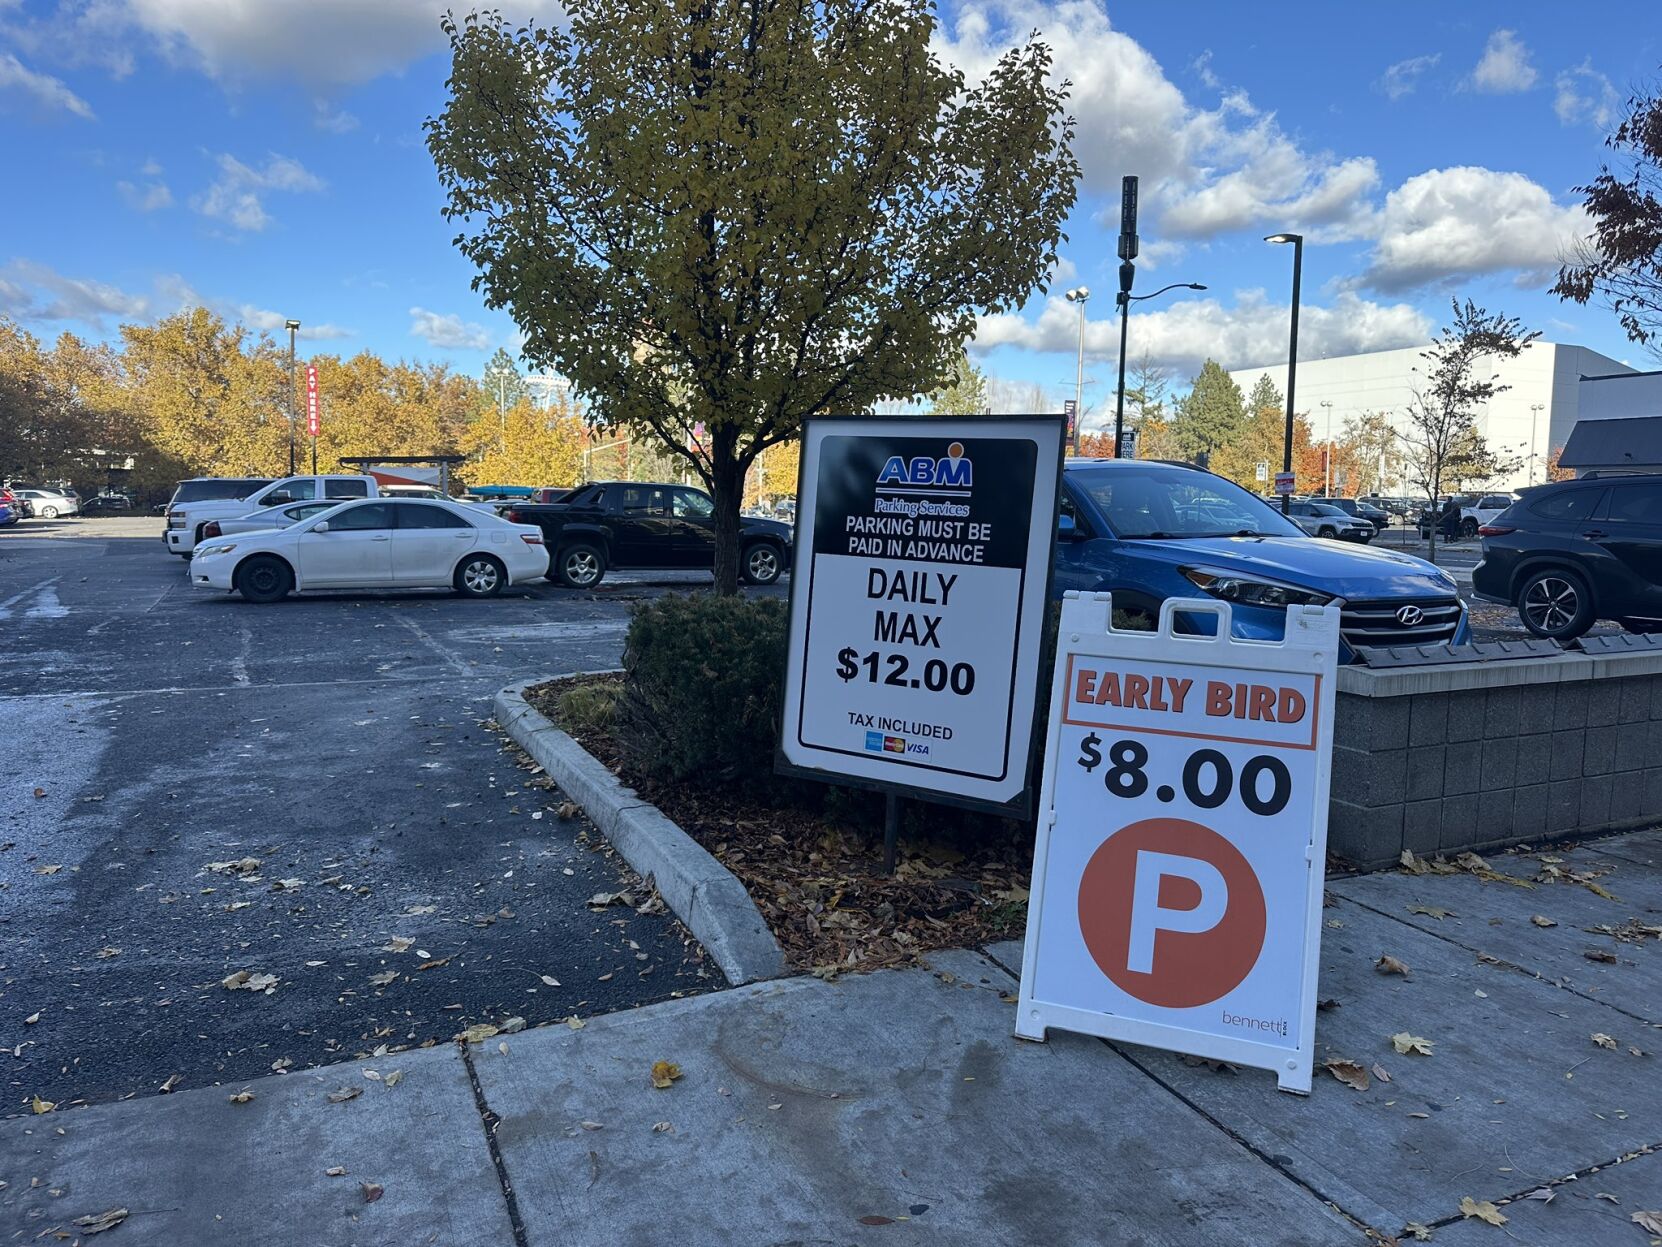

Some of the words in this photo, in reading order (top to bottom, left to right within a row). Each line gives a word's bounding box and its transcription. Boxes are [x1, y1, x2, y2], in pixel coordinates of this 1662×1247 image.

[308, 367, 316, 389] PAY
[309, 391, 317, 420] HERE
[1122, 441, 1133, 450] ARK
[1122, 450, 1133, 459] ERE
[876, 455, 973, 487] ABM
[874, 497, 919, 518] Parking
[919, 500, 970, 517] Services
[845, 515, 914, 536] PARKING
[917, 519, 965, 539] MUST
[968, 523, 992, 541] BE
[848, 536, 883, 555] PAID
[887, 539, 902, 556] IN
[905, 541, 985, 562] ADVANCE
[867, 567, 958, 606] DAILY
[874, 610, 942, 649] MAX
[836, 646, 976, 696] $12.00
[1075, 669, 1194, 713] EARLY
[1205, 680, 1306, 724] BIRD
[847, 711, 875, 729] TAX
[878, 716, 953, 741] INCLUDED
[907, 742, 929, 755] VISA
[1077, 731, 1292, 816] $8.00
[1126, 849, 1228, 975] P
[1222, 1009, 1281, 1035] bennett
